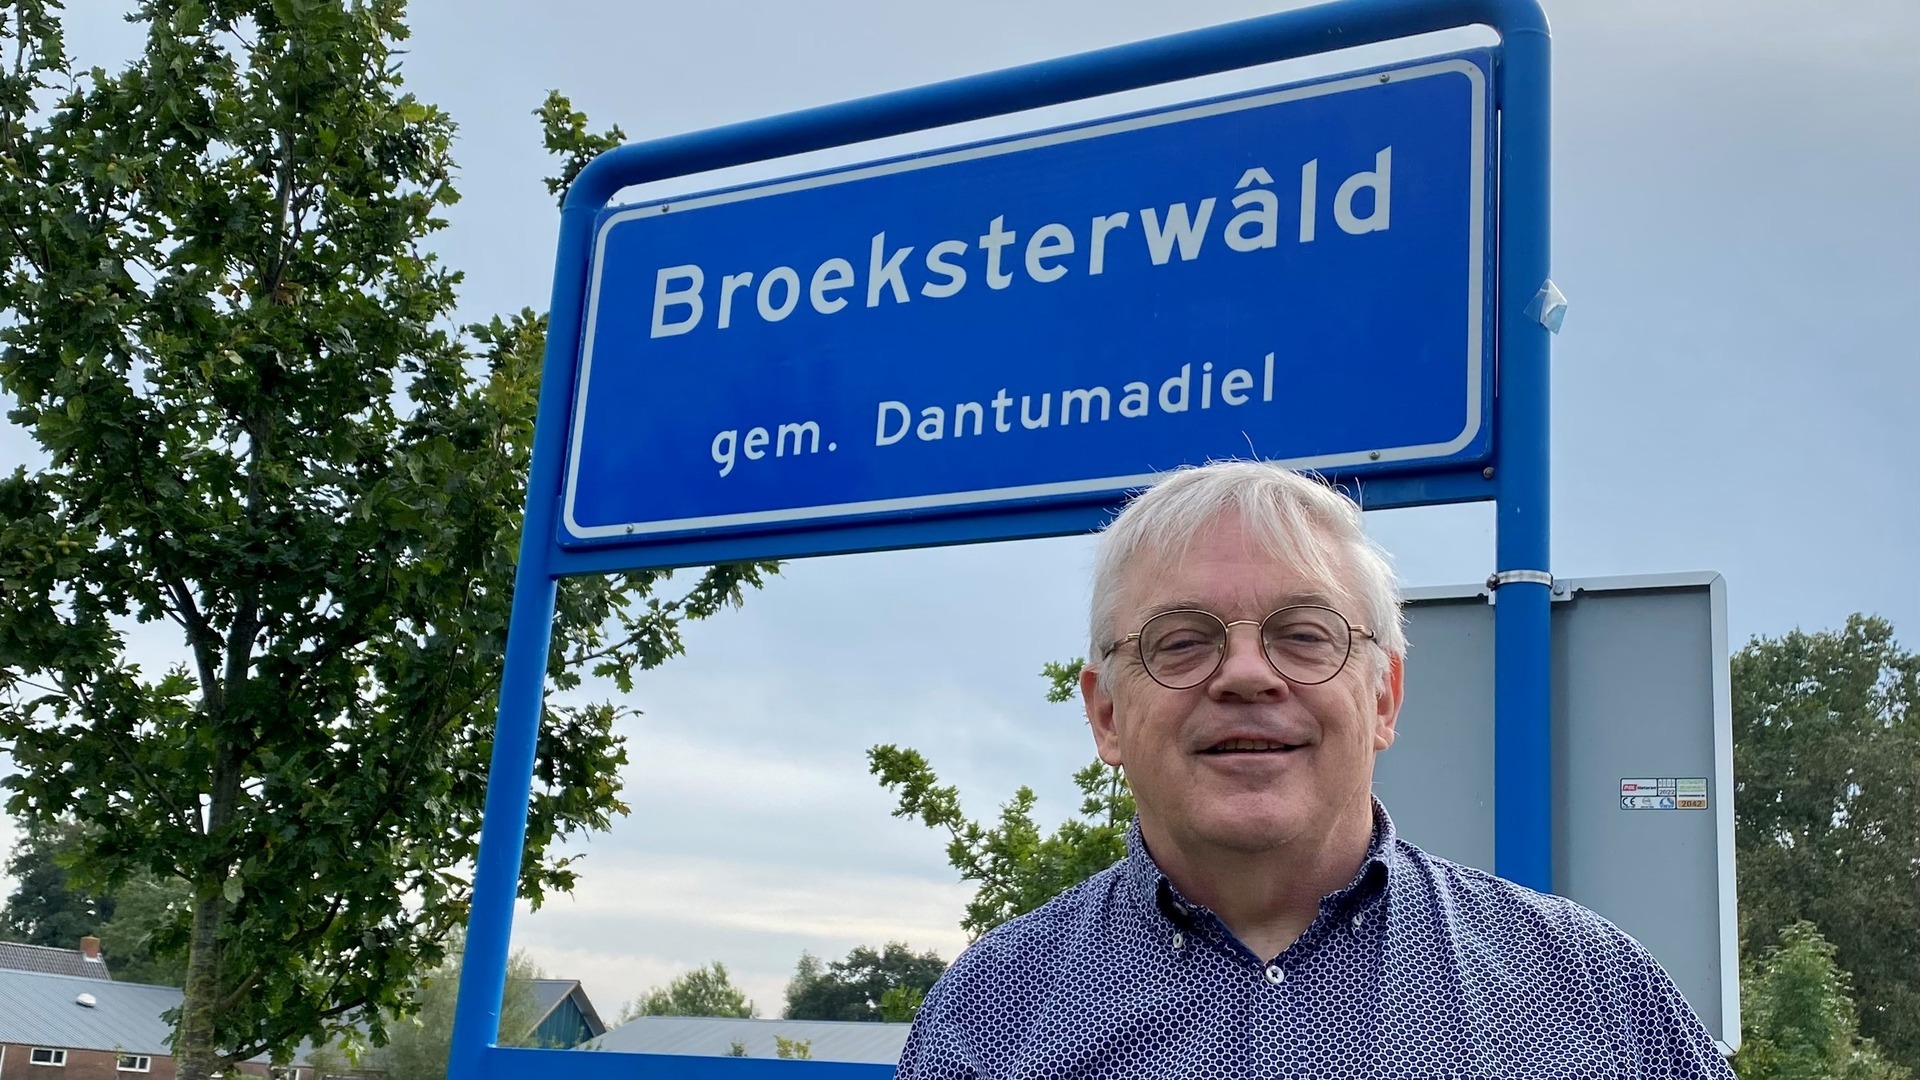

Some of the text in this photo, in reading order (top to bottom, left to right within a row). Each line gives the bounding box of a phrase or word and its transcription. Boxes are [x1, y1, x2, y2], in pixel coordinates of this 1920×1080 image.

[650, 146, 1392, 338] Broeksterwâld
[711, 352, 1274, 477] gem. Dantumadiel
